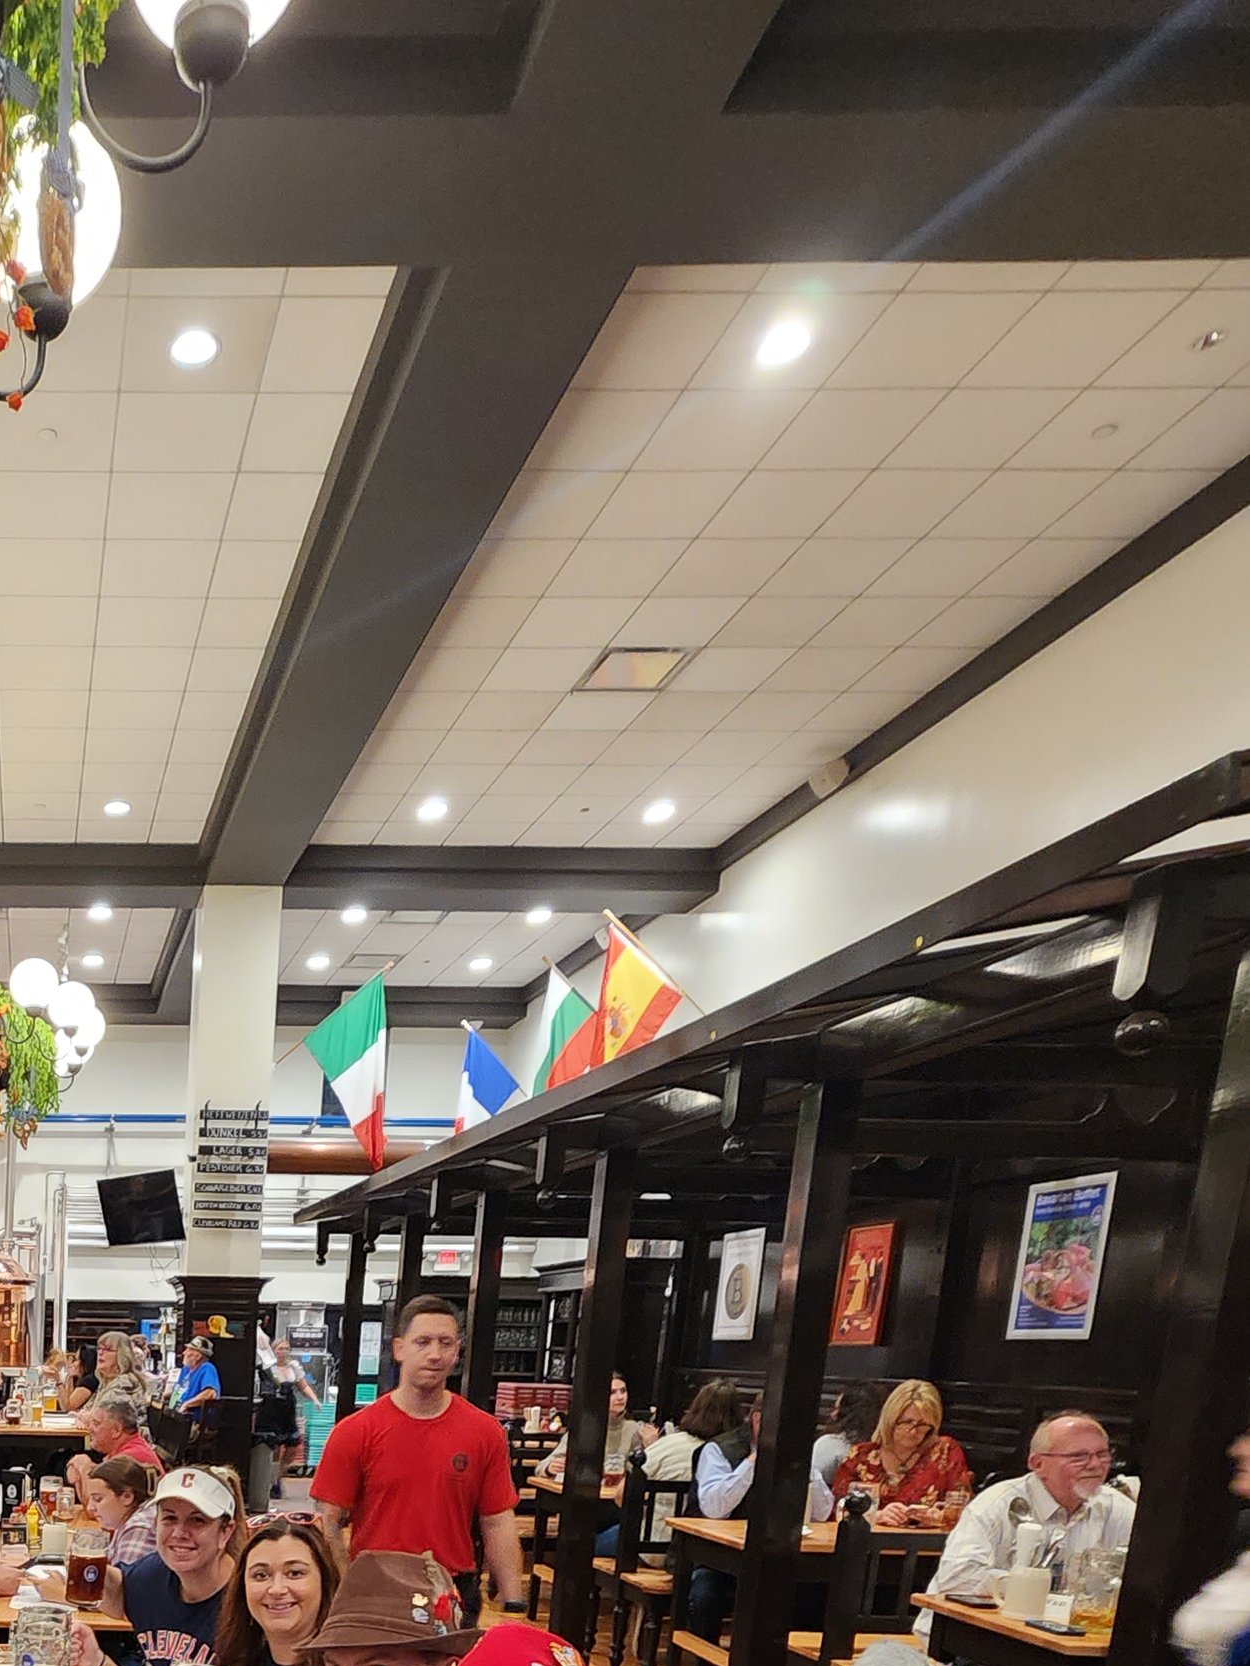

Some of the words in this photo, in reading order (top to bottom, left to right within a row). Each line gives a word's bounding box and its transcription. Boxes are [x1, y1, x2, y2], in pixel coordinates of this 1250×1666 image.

[206, 1128, 247, 1138] DUNKEL
[212, 1146, 243, 1155] LAGER
[199, 1163, 243, 1172] FESTBIER
[180, 1473, 195, 1488] C
